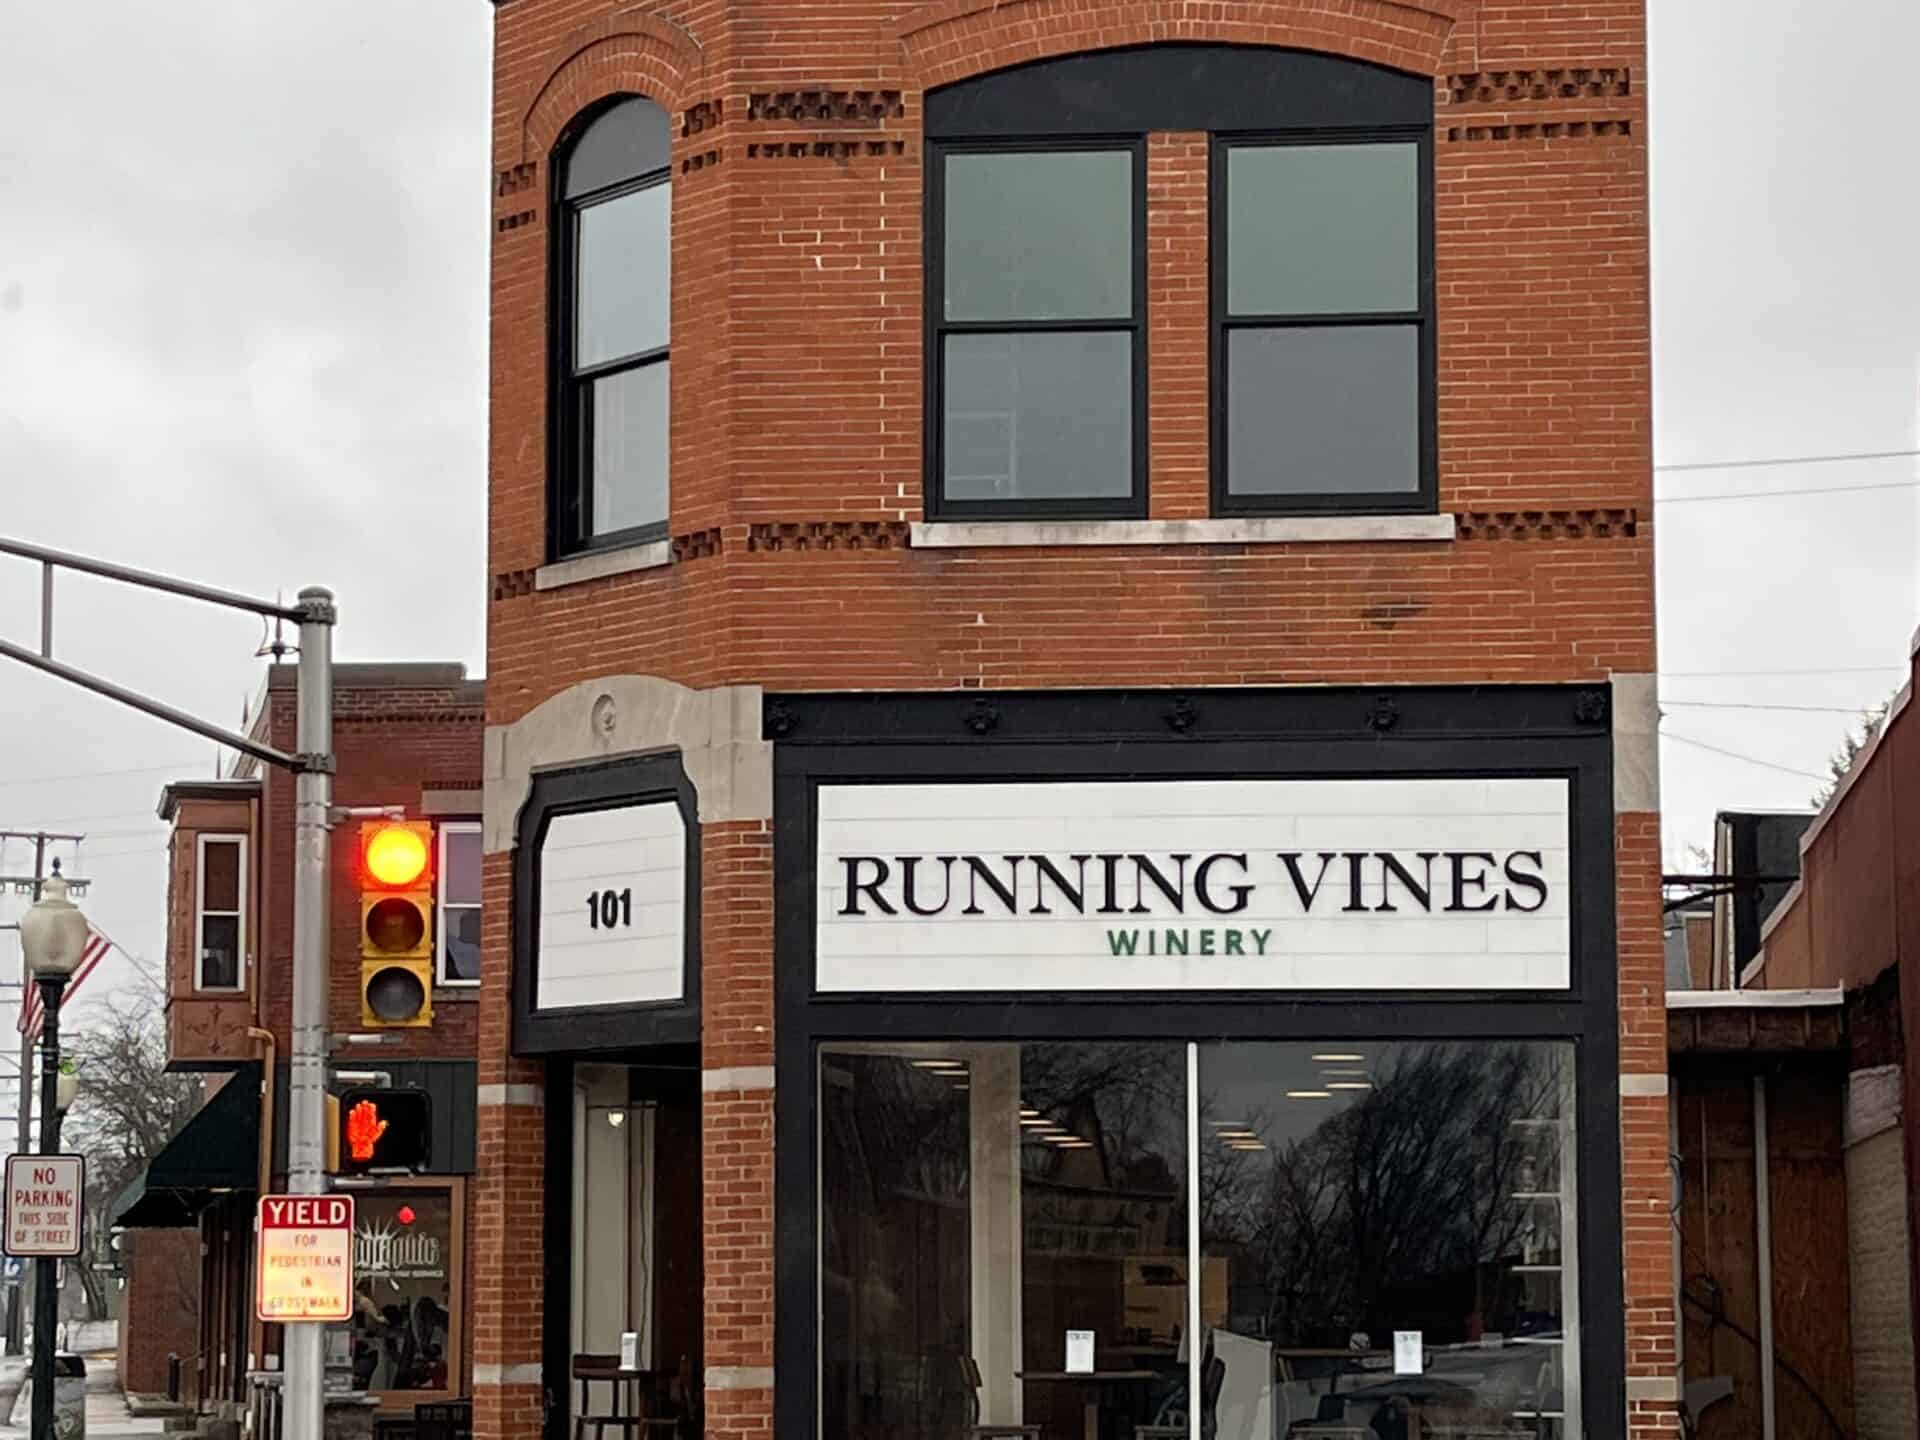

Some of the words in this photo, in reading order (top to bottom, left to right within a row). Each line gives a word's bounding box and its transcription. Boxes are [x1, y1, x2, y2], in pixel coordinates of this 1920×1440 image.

[837, 853, 1256, 916] RUNNING
[1276, 850, 1548, 913] VINES
[586, 888, 631, 930] 101
[1107, 928, 1274, 957] WINERY
[33, 1167, 56, 1185] NO
[15, 1189, 73, 1207] PARKING
[19, 1211, 41, 1225] THIS
[47, 1211, 69, 1226] SIDE
[268, 1200, 346, 1225] YIELD
[15, 1230, 26, 1243] OF
[34, 1230, 71, 1244] STREET
[294, 1234, 318, 1247] FOR
[270, 1255, 341, 1267] PEDESTRIAN
